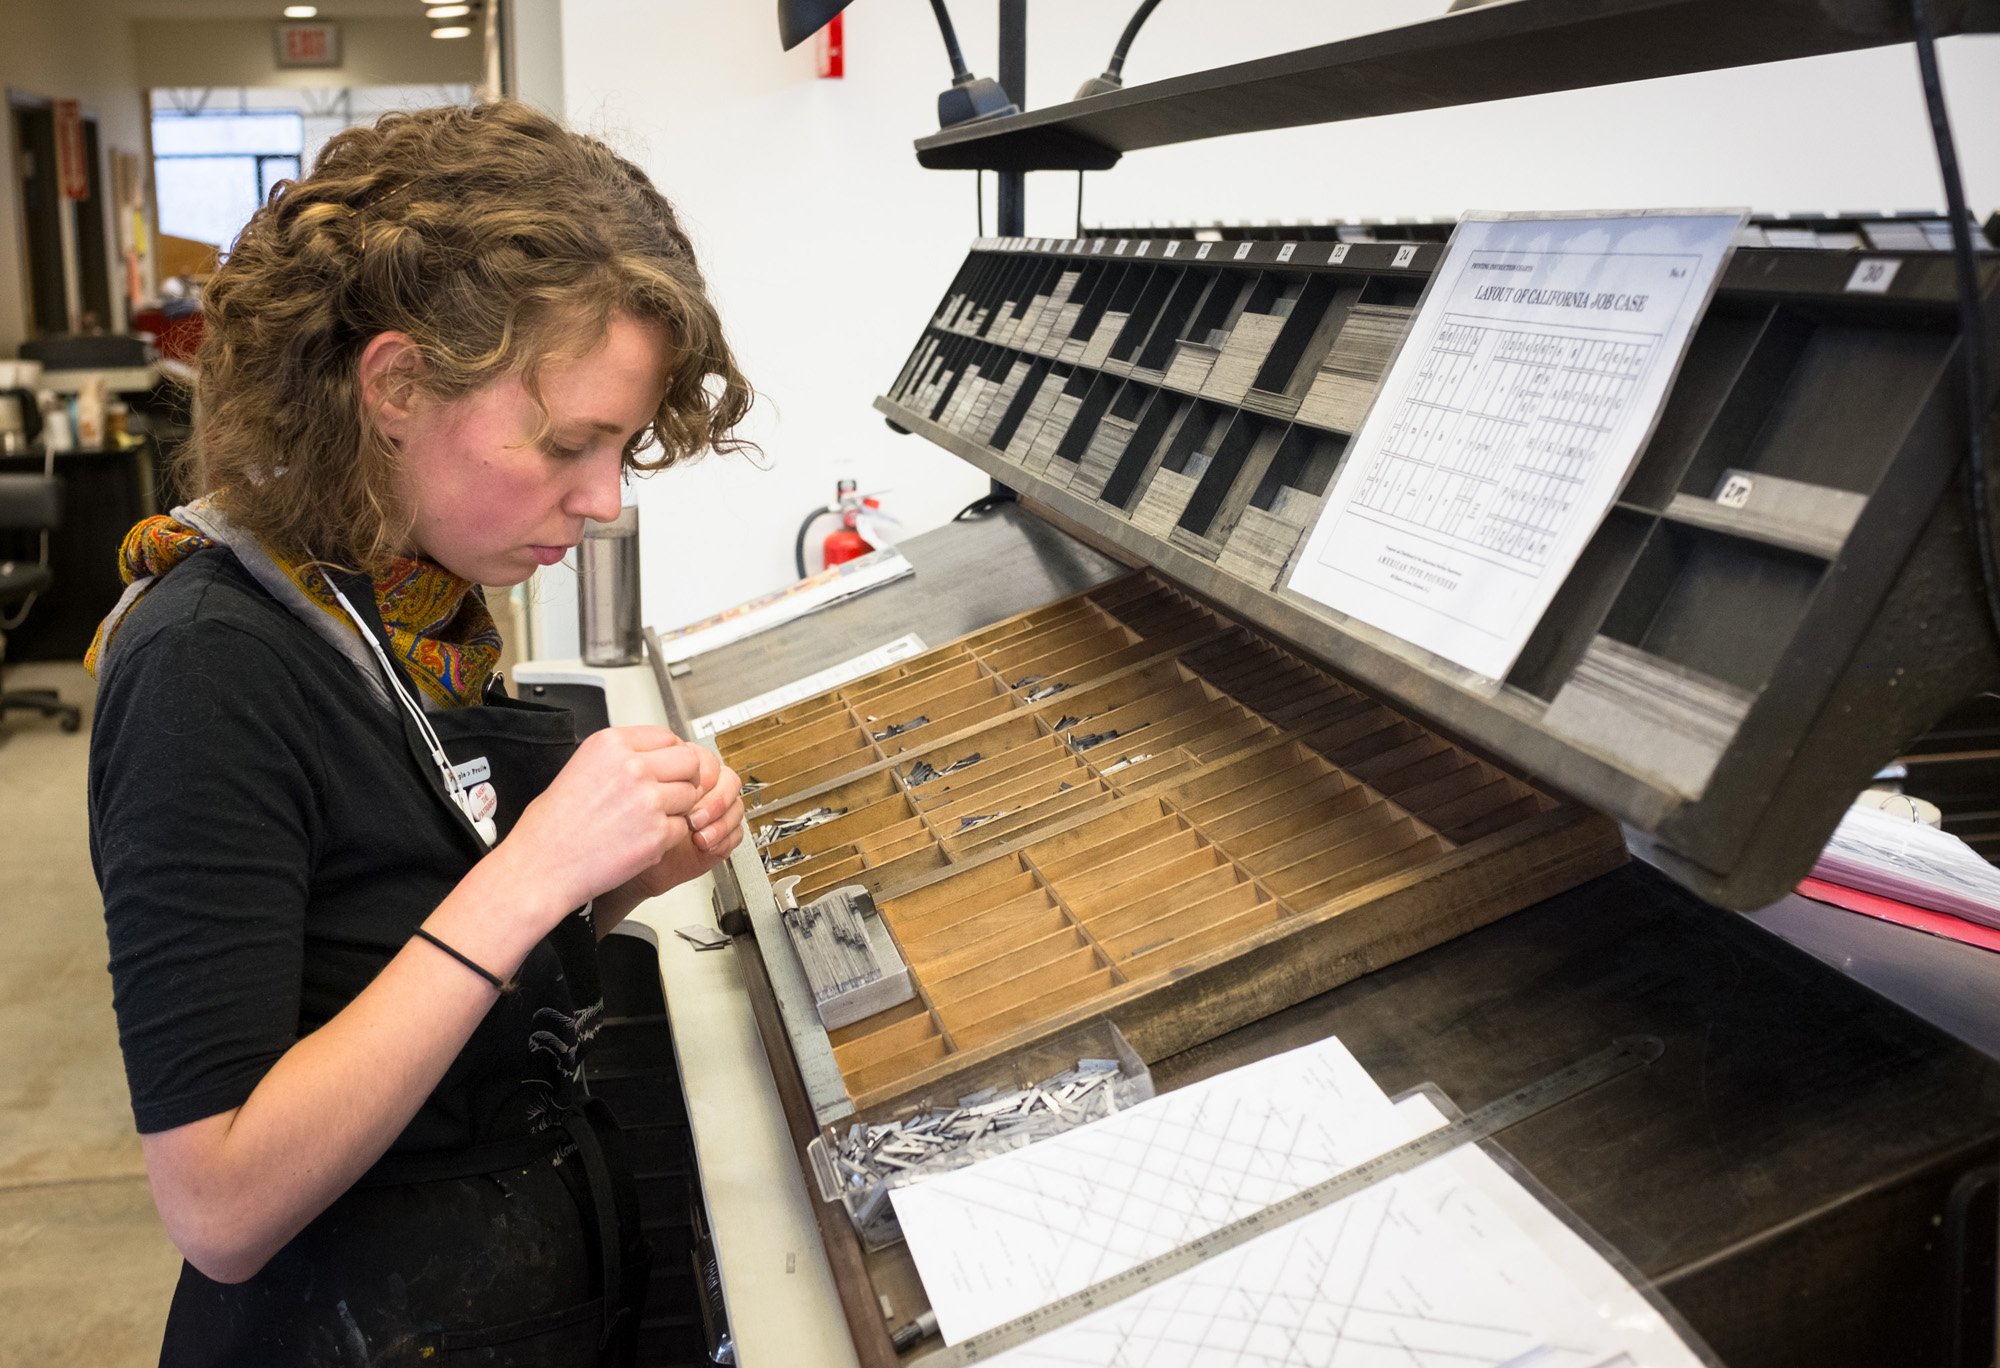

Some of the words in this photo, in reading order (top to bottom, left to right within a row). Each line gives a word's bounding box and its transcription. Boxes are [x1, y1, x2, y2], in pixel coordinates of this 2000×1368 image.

[1282, 246, 1291, 257] 22
[1334, 246, 1345, 258] 23
[1399, 249, 1411, 261] 24
[1862, 264, 1884, 282] 30
[1474, 285, 1515, 301] LAYOUT
[1511, 288, 1530, 302] OF
[1525, 288, 1593, 308] CALIFORNIA
[1588, 292, 1617, 309] JOB
[1612, 294, 1650, 312] CASE
